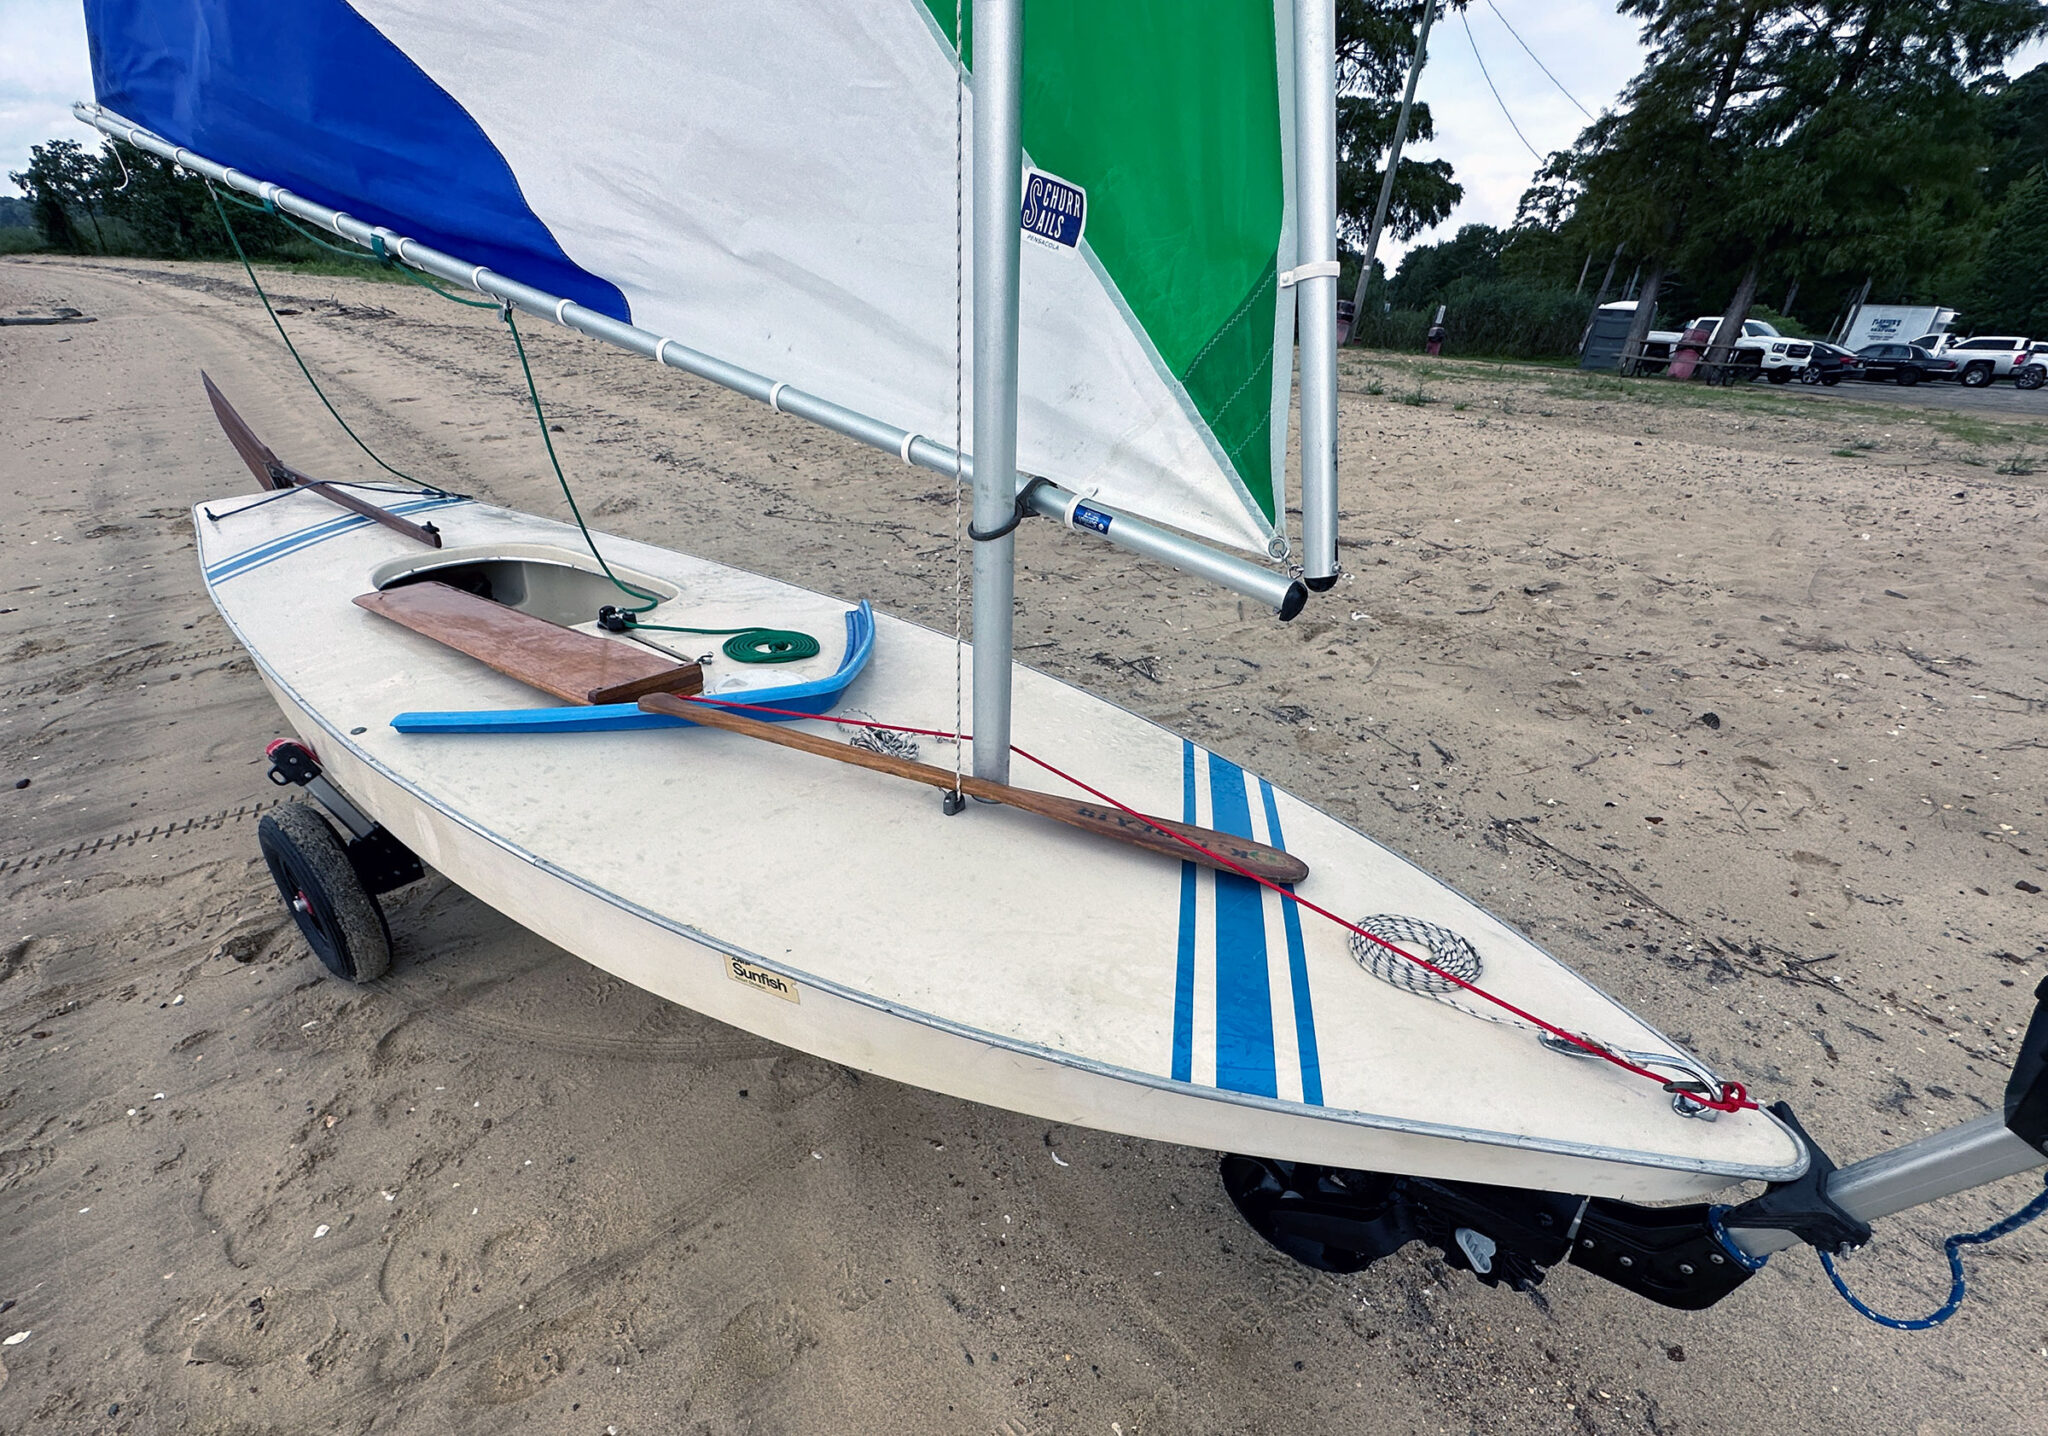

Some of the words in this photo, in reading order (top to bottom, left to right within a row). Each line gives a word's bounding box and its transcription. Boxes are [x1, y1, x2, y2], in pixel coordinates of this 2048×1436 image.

[1022, 178, 1080, 228] SCHURR
[1027, 234, 1060, 250] PENSACOLA
[732, 962, 788, 993] Sunfish
